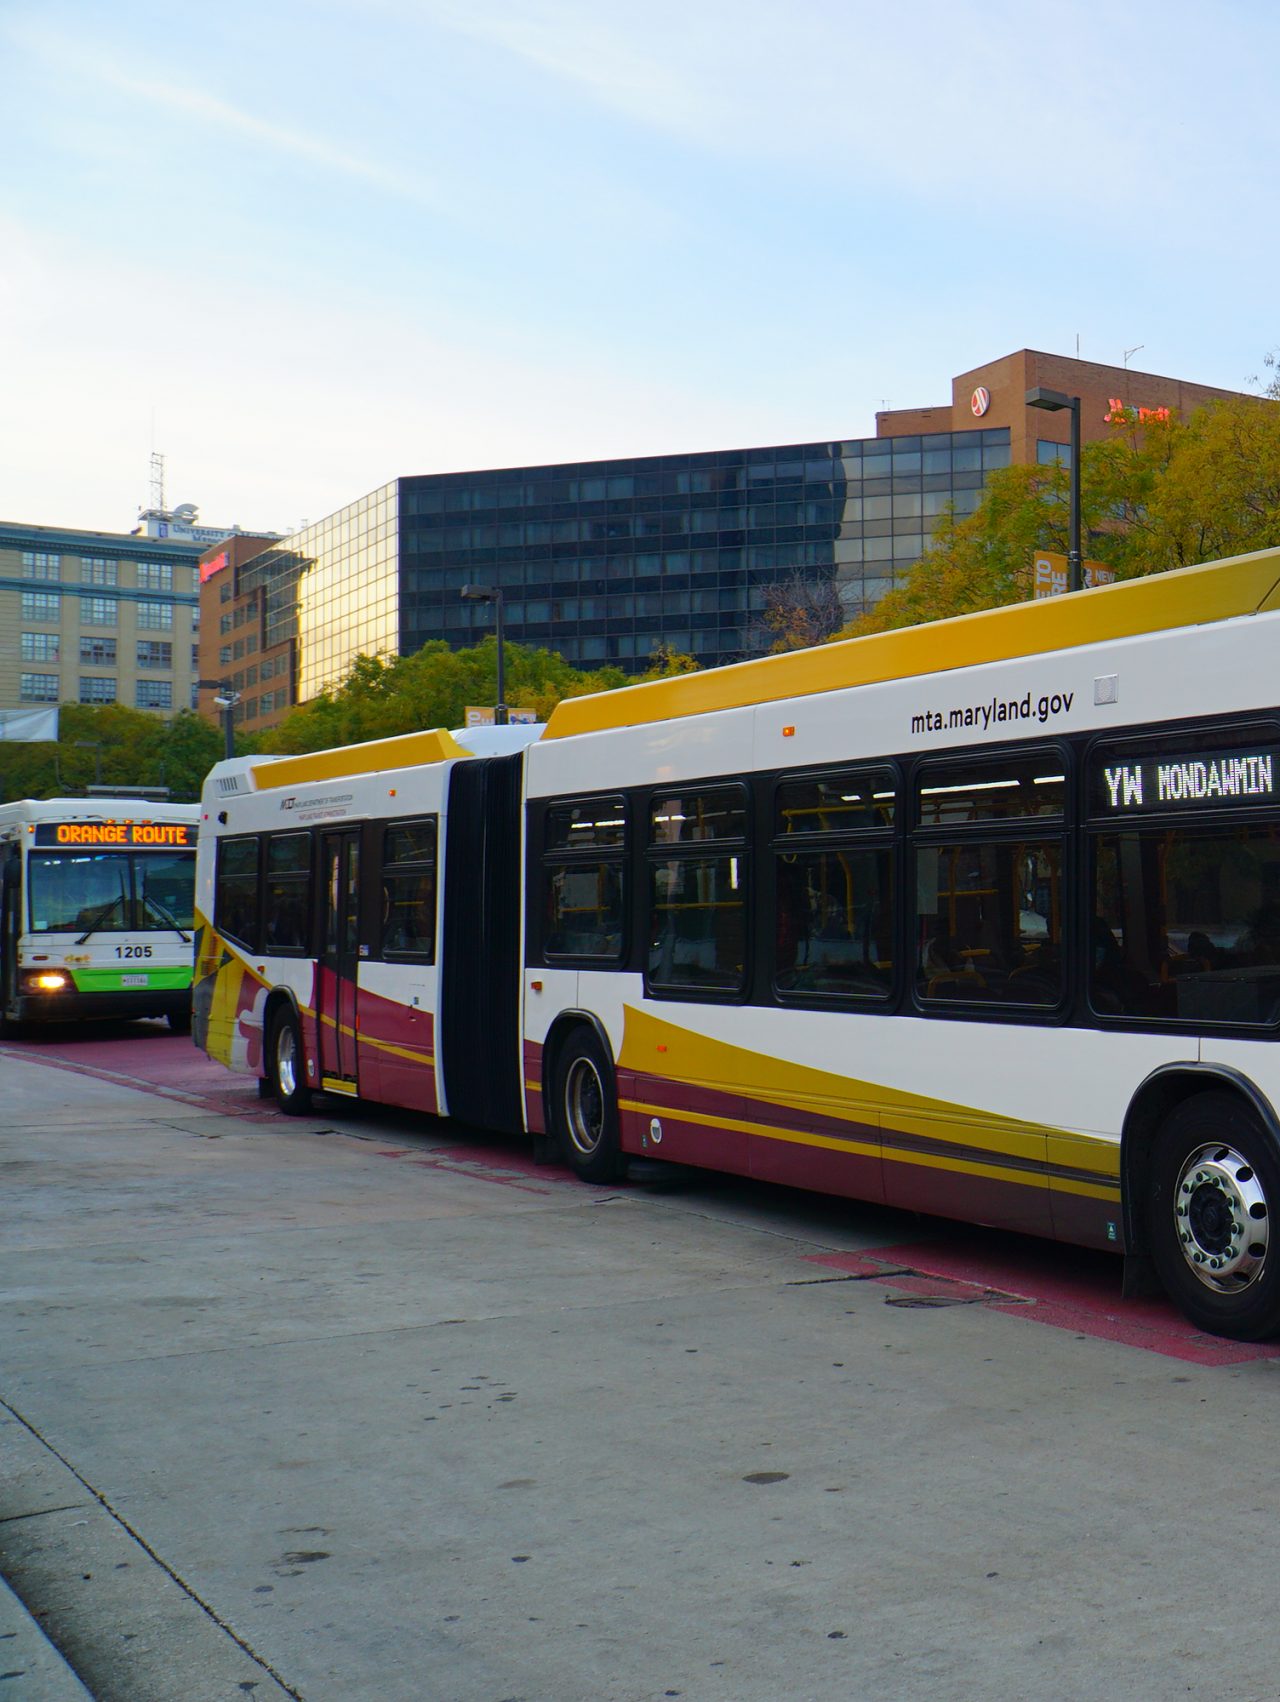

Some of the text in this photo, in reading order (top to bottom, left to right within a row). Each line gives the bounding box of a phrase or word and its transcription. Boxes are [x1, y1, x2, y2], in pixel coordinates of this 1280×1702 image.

[911, 692, 1074, 734] mta.maryland.gov
[1104, 755, 1273, 807] YW MONDAWMIN
[57, 825, 188, 845] ORANGE ROUTE
[115, 946, 153, 959] 1205
